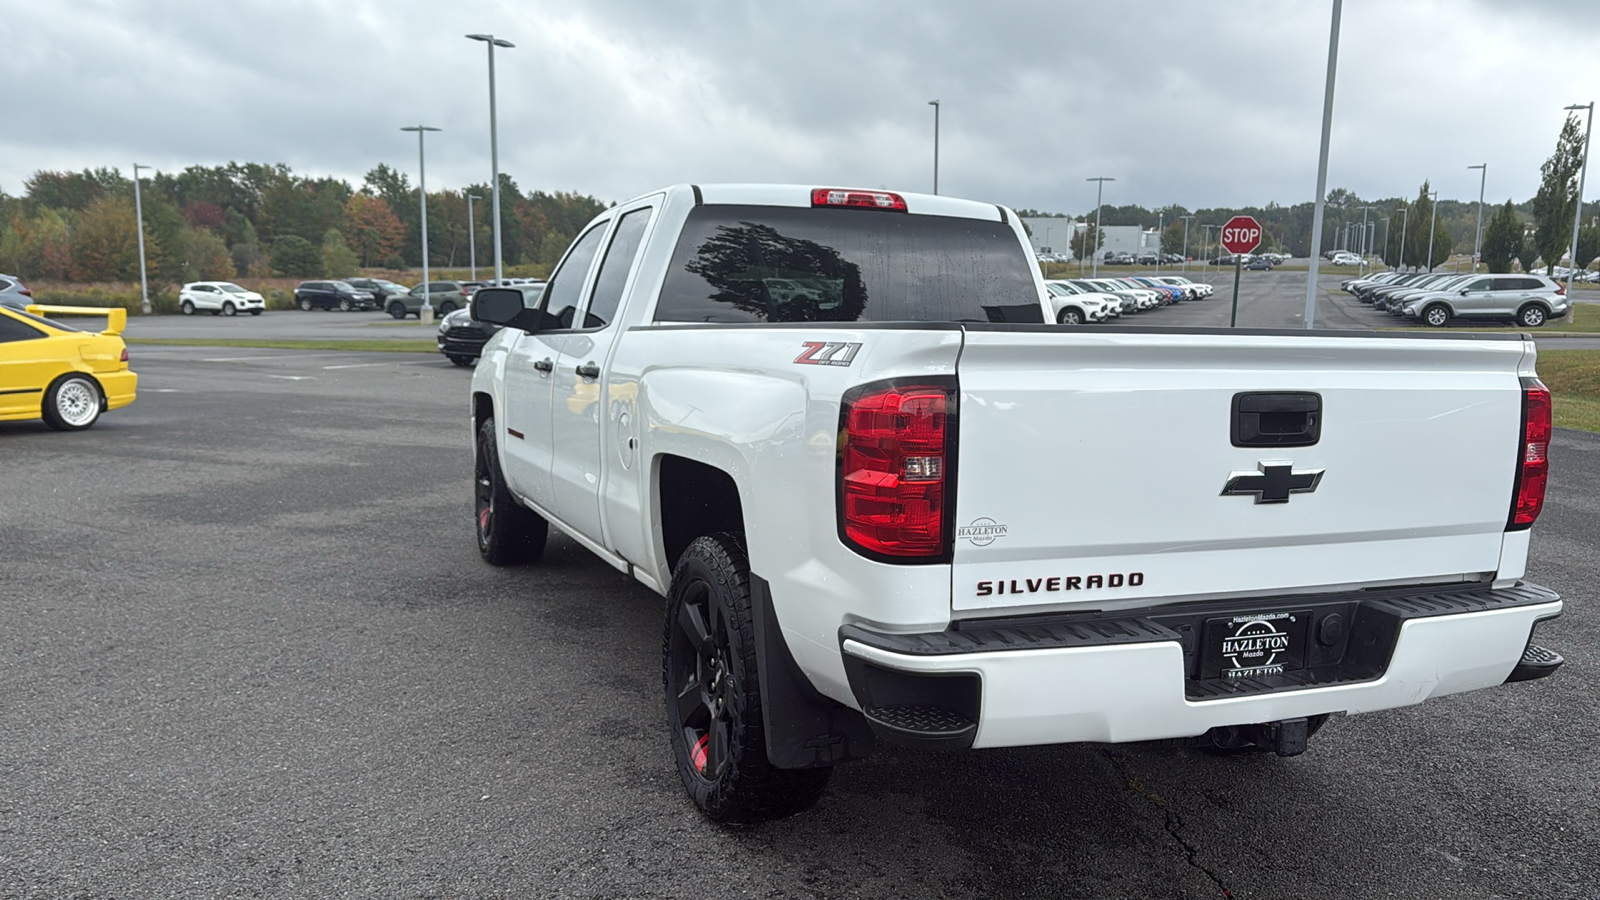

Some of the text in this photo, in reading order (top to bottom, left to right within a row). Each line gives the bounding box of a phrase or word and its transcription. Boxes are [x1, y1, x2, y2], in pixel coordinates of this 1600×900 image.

[1223, 228, 1259, 243] STOP
[793, 341, 863, 366] Z71
[958, 526, 1008, 536] HAZLETON
[976, 572, 1144, 596] SILVERADO
[1233, 613, 1289, 623] HazletonMazda.com
[1222, 636, 1289, 653] HAZLETON
[1242, 650, 1264, 658] Mazda
